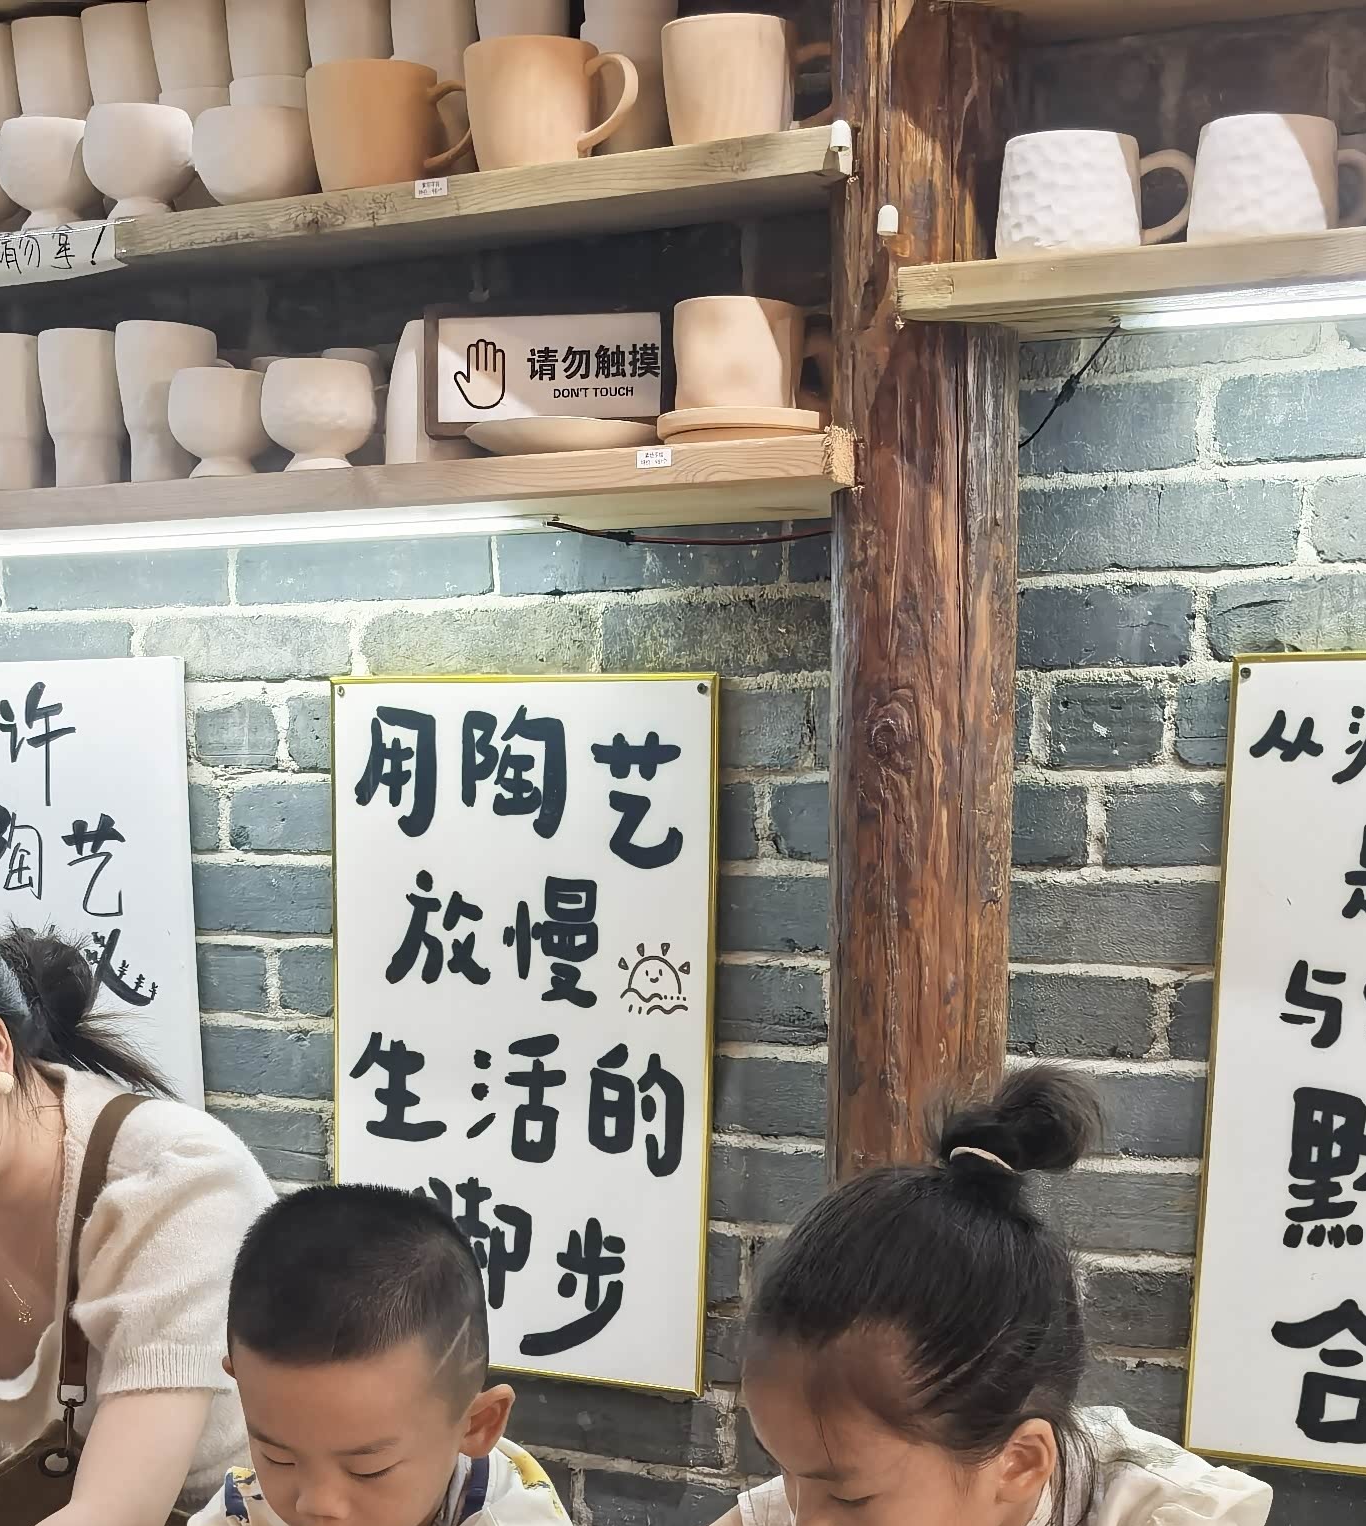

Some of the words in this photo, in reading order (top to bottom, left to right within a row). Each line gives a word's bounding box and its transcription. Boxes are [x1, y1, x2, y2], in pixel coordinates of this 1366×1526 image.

[527, 343, 661, 382] 请勿触摸
[553, 387, 590, 399] DON'T
[592, 385, 634, 398] TOUCH
[354, 704, 684, 870] 用陶艺
[385, 869, 599, 1009] 放慢
[349, 1031, 685, 1178] 生活的
